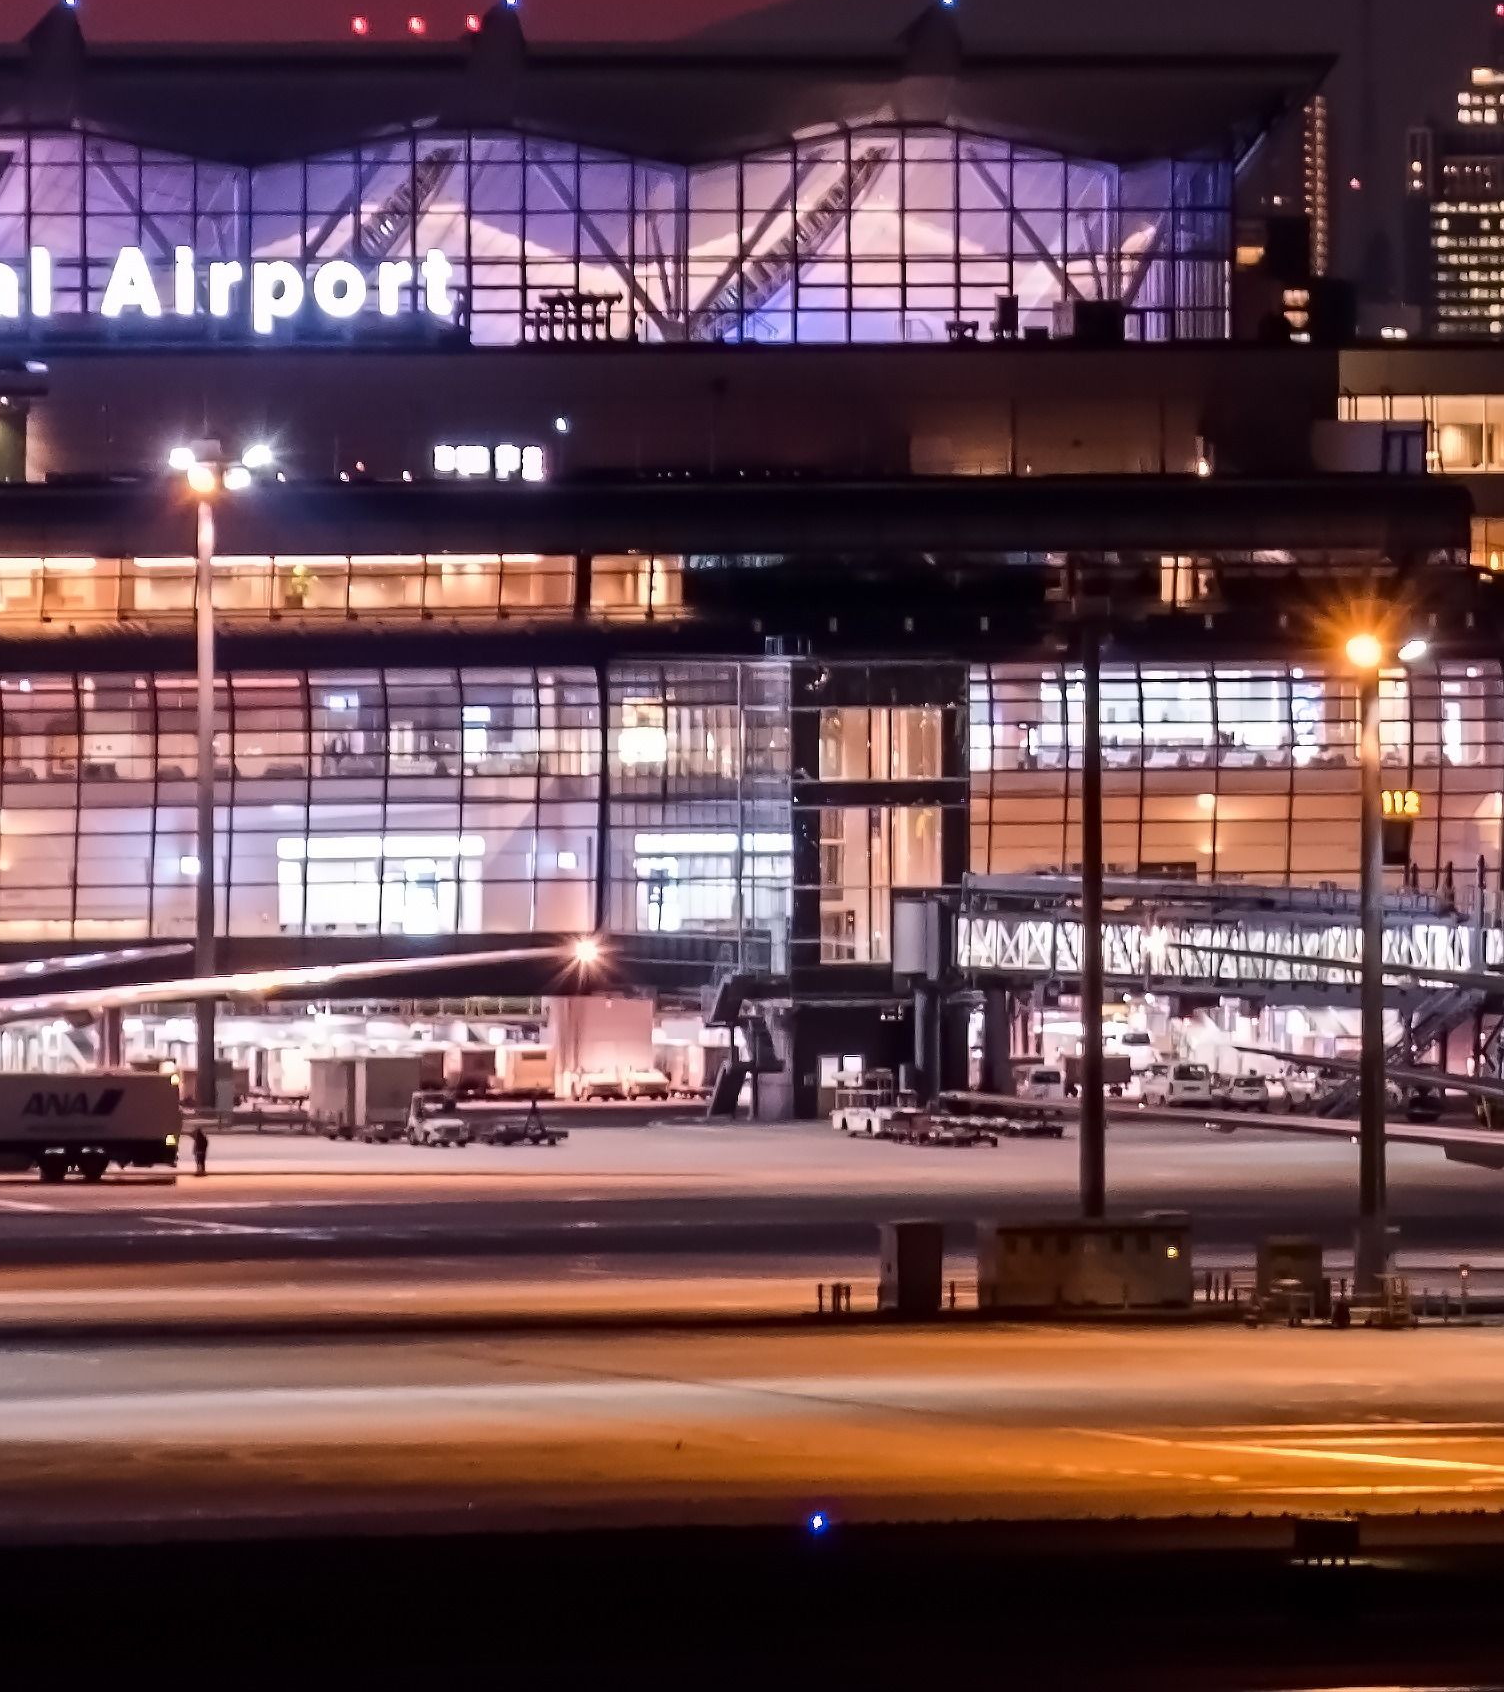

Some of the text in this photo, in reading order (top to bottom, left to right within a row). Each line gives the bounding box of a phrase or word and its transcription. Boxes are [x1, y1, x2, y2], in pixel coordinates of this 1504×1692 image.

[99, 244, 454, 334] Airport
[1380, 789, 1420, 814] 112
[21, 1091, 90, 1116] ANA
